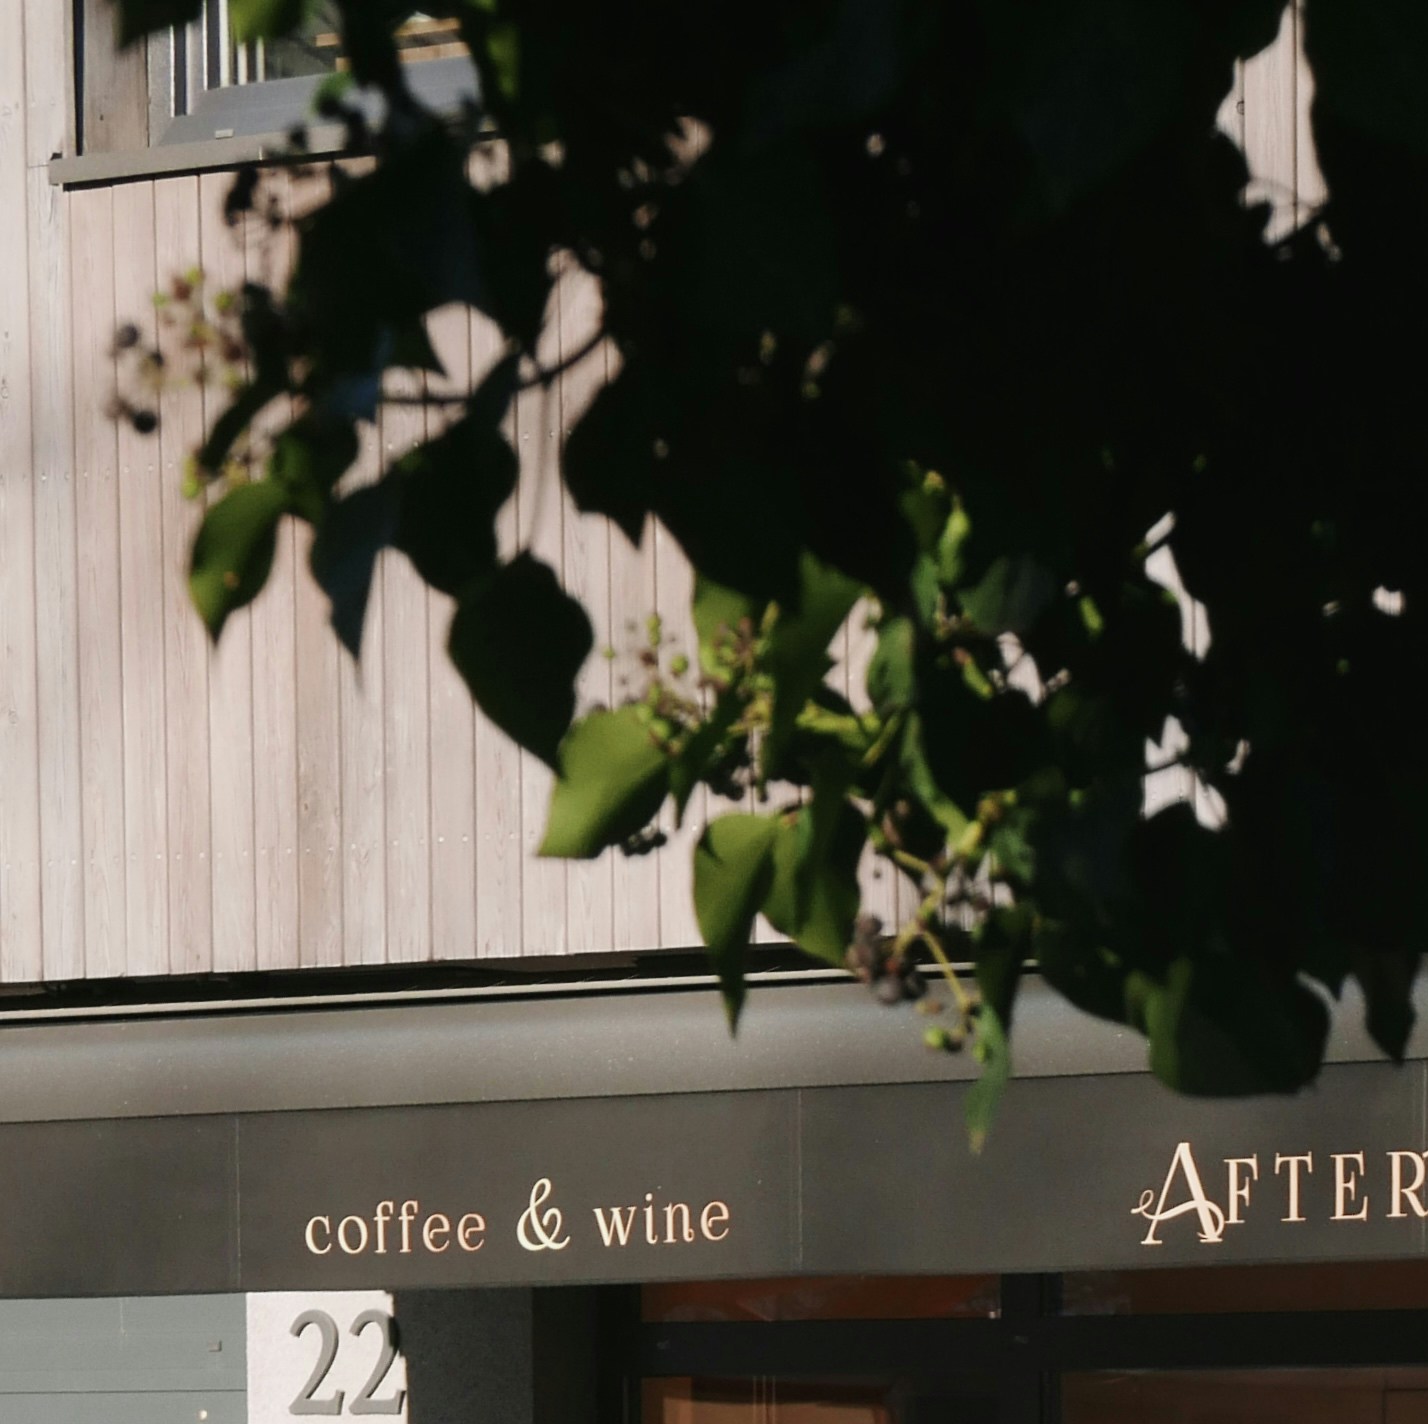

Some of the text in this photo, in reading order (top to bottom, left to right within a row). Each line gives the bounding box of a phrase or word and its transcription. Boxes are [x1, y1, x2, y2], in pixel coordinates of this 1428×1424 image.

[305, 1177, 731, 1255] coffee & wine
[288, 1309, 406, 1416] 22
